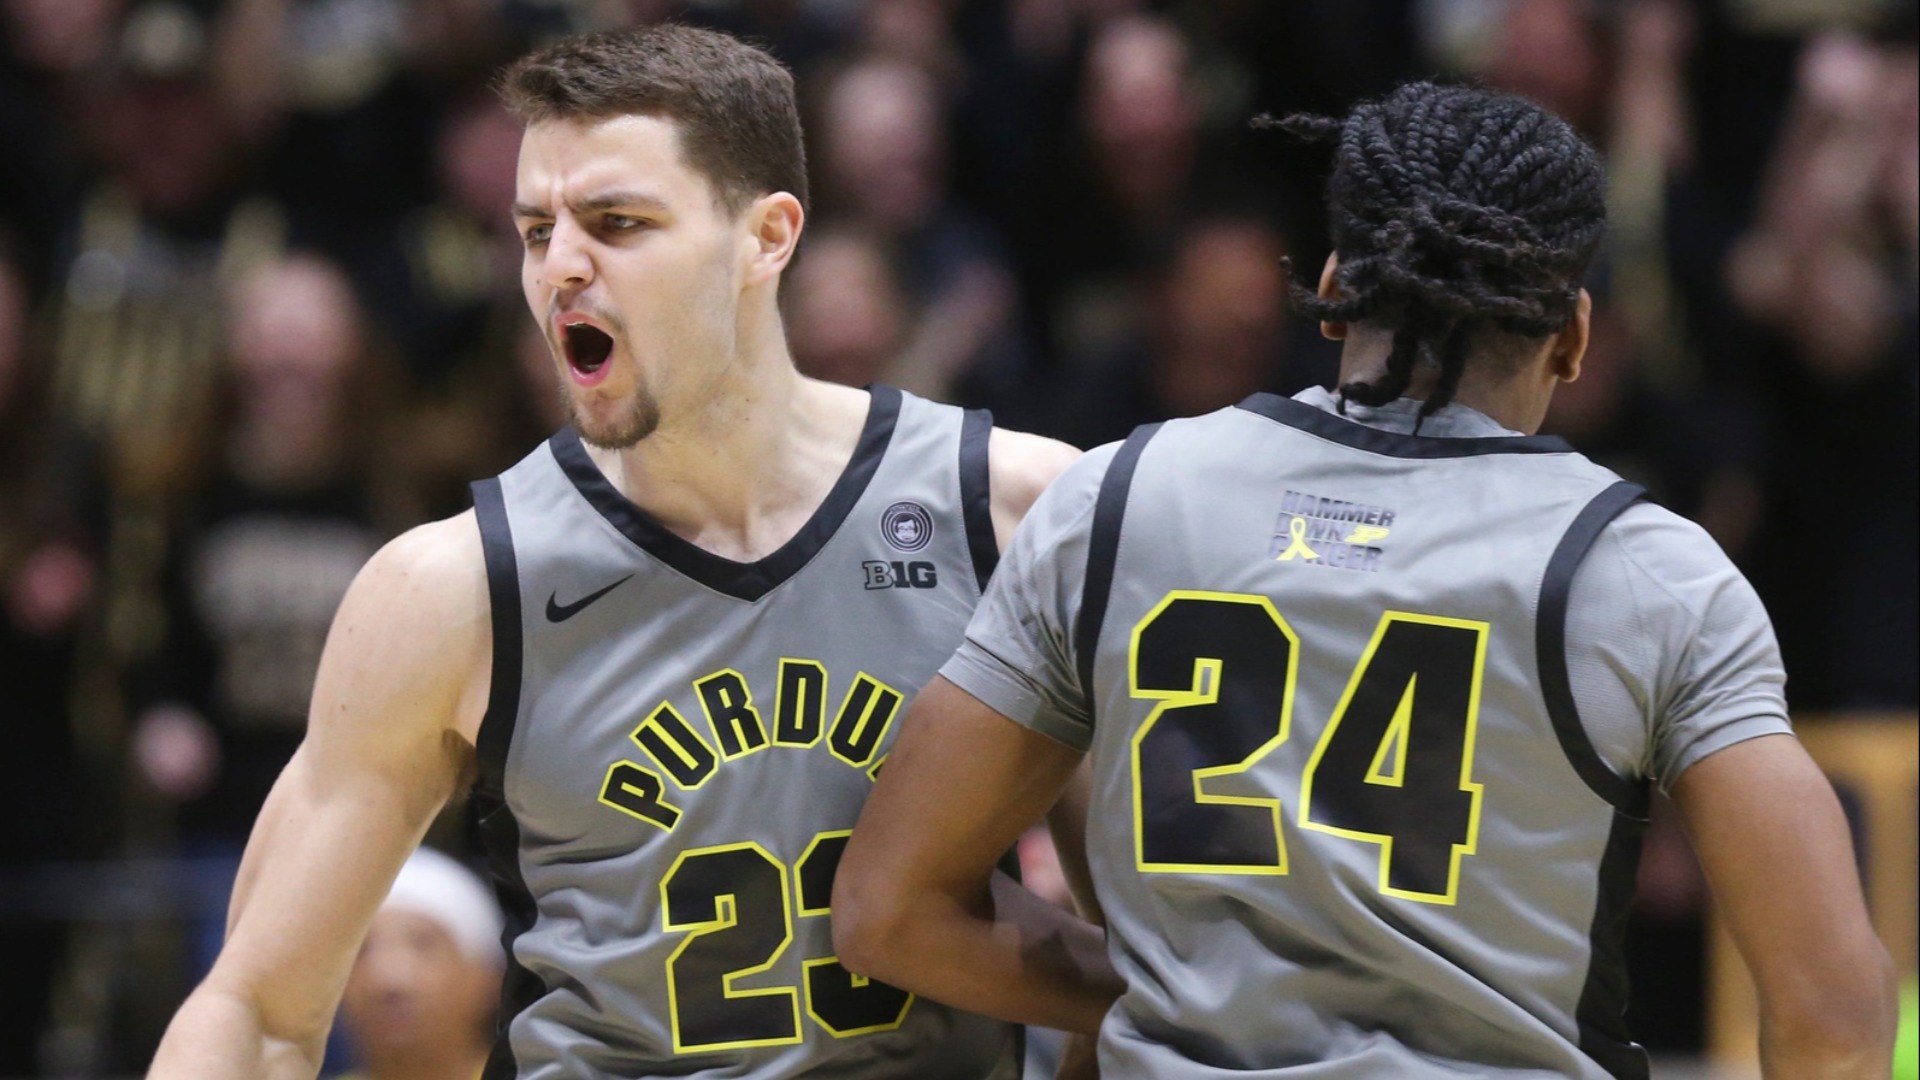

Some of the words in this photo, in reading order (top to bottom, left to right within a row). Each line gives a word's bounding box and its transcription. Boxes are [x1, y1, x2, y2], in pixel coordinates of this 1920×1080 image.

[1280, 489, 1396, 526] HAMMER
[1274, 512, 1344, 542] DWN
[1268, 535, 1384, 572] CNCER
[597, 657, 904, 833] PURDU
[1129, 590, 1490, 906] 24
